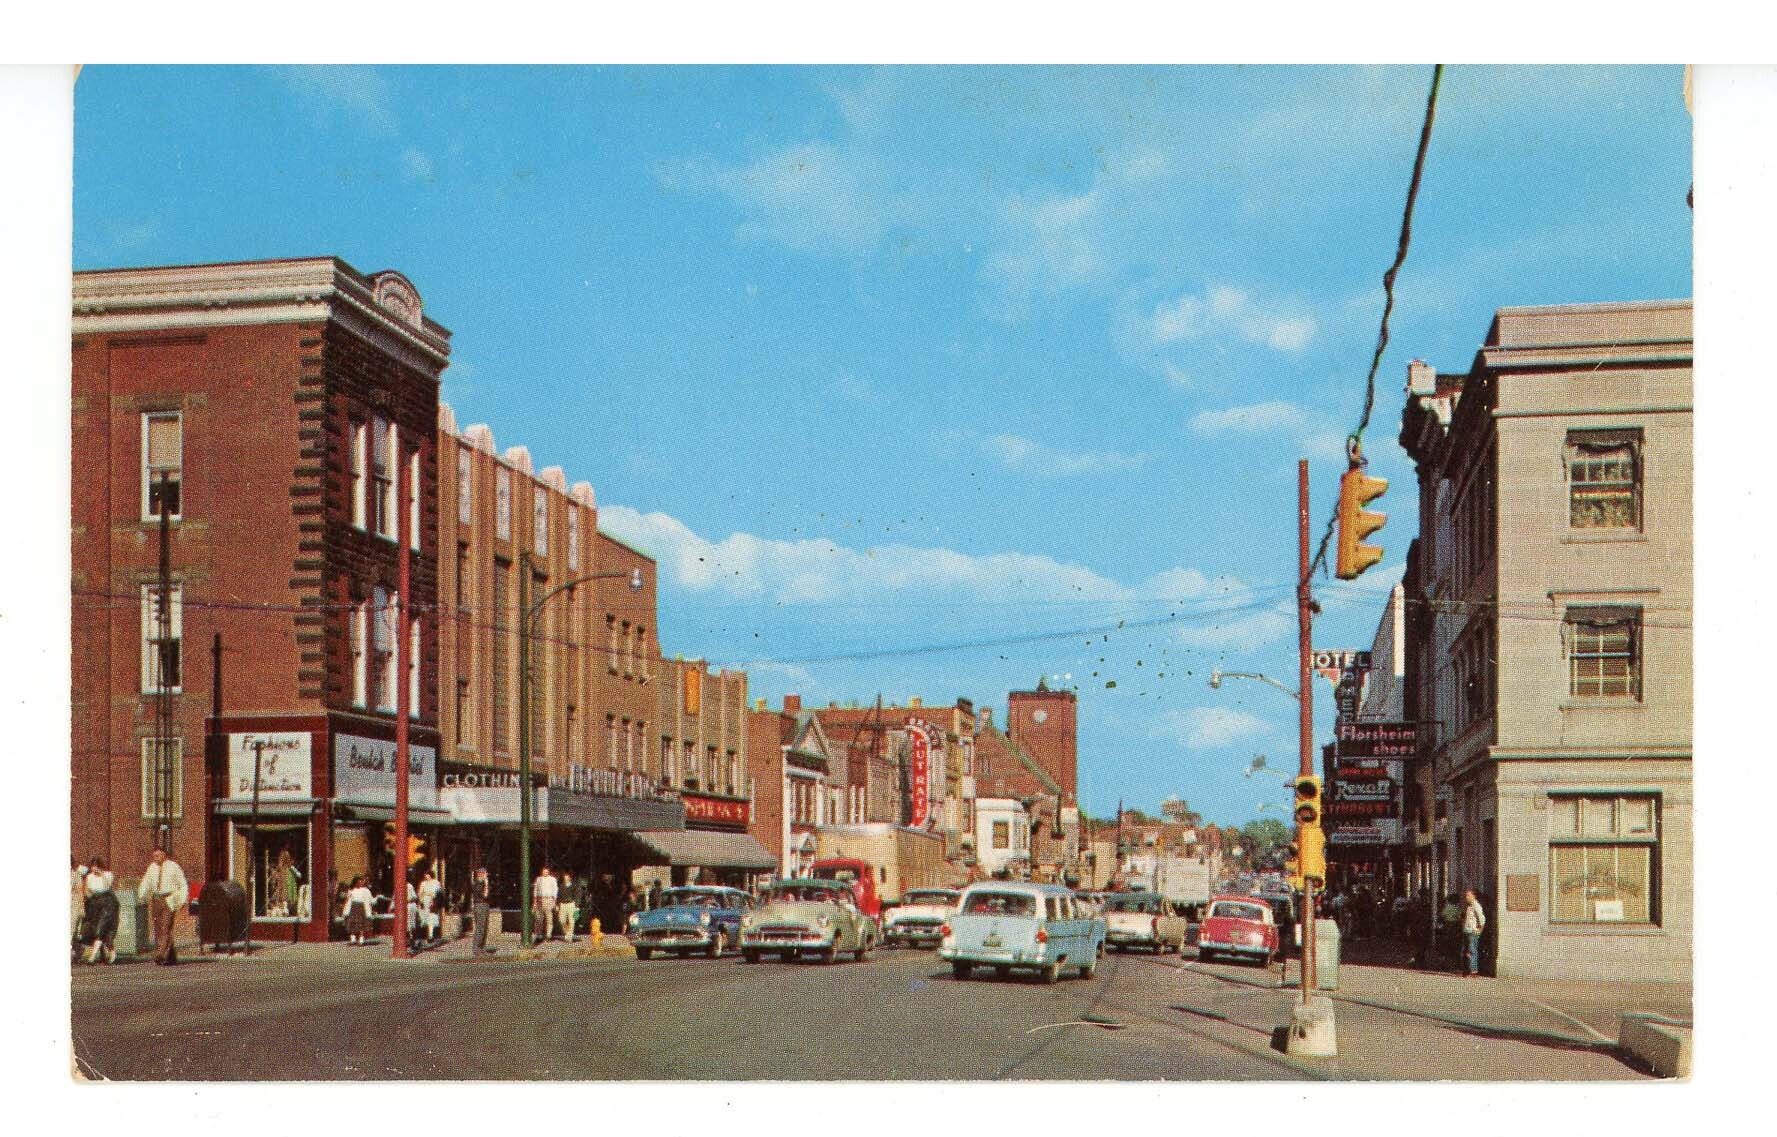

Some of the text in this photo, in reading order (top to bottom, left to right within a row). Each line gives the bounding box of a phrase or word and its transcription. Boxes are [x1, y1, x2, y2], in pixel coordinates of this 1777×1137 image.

[1341, 724, 1415, 741] Florsheim
[1372, 741, 1415, 755] shoes
[264, 753, 279, 776] of
[239, 777, 302, 793] Ditinction
[915, 739, 926, 818] CUT RATE
